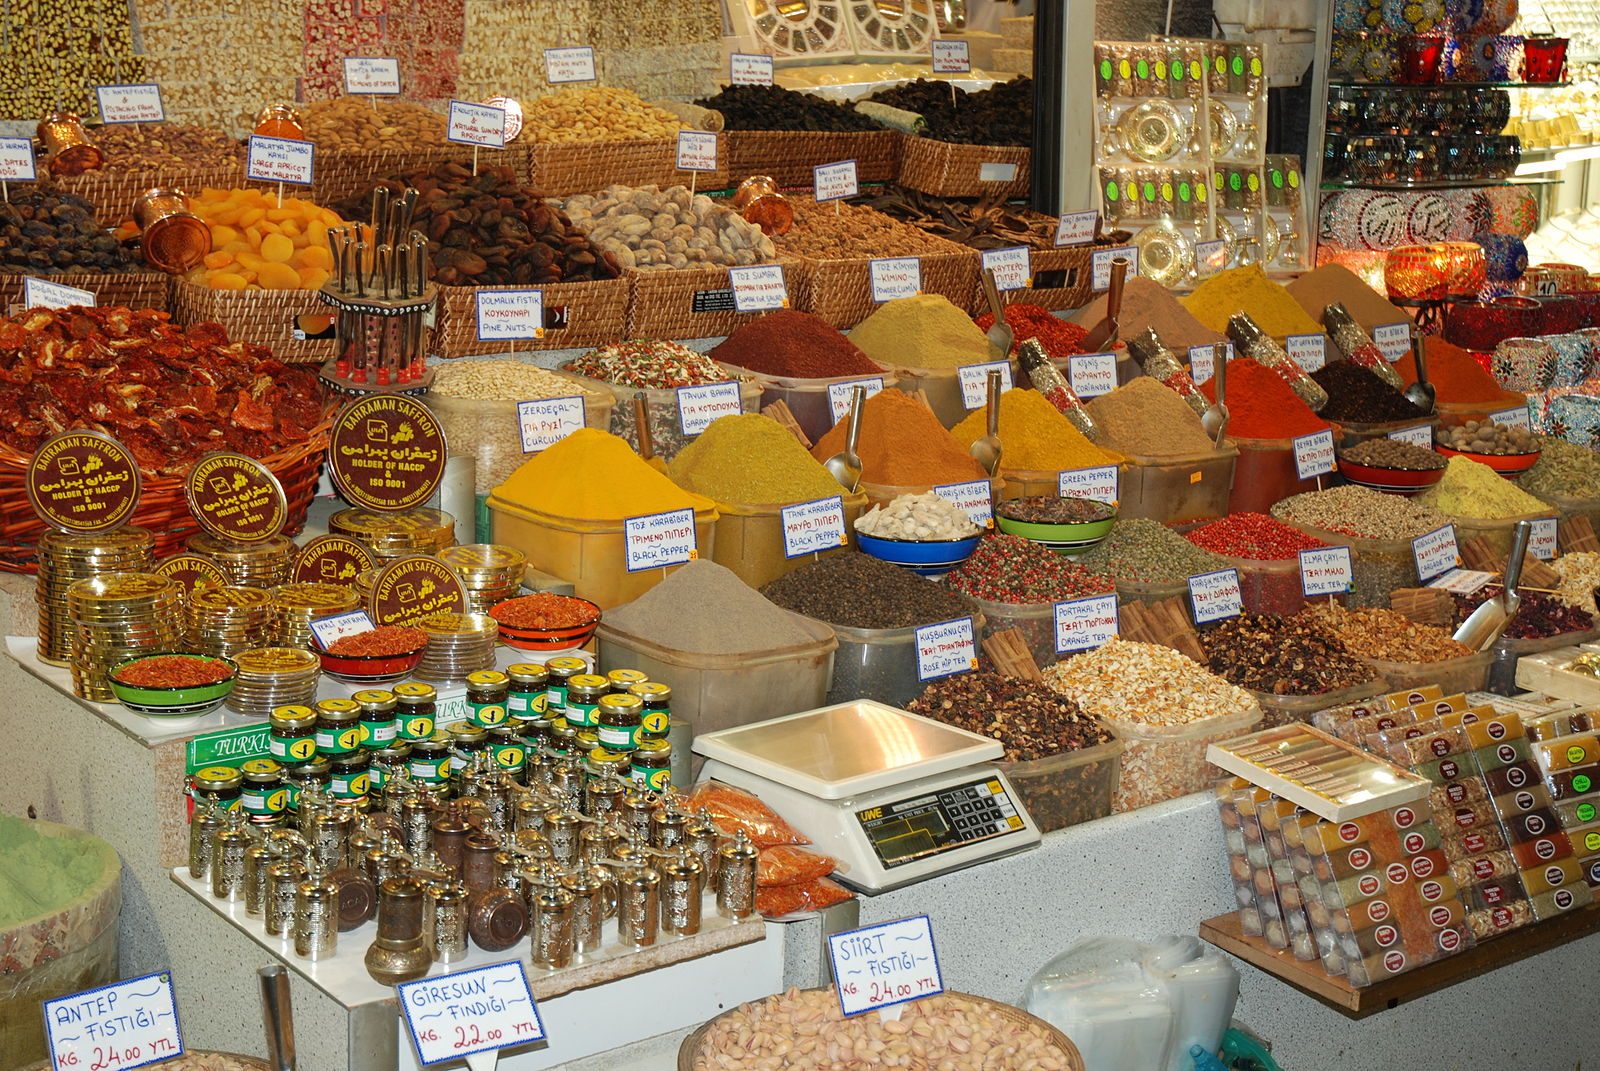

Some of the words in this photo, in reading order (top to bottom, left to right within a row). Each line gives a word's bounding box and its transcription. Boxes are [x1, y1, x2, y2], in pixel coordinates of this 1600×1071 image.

[454, 122, 478, 132] NATURAL
[462, 132, 488, 142] APRICOT
[252, 142, 284, 150] MALATYA
[286, 144, 309, 154] JUMBO
[268, 152, 288, 160] KAYISI
[252, 159, 273, 168] LARGE
[277, 162, 306, 173] APRICOT
[252, 168, 270, 176] FROM
[272, 171, 302, 180] MALATYA
[736, 272, 750, 281] TOZ
[481, 296, 515, 305] DOLMALIK
[483, 323, 502, 332] PINE
[505, 323, 527, 332] NUTS
[683, 391, 707, 400] TAVUK
[710, 388, 736, 398] BAHARI
[344, 400, 396, 430] BAHRAMAN
[397, 401, 436, 438] SAFFRON
[522, 404, 570, 417] ZERDEÇAL
[36, 437, 80, 471] BAHRAMAN
[81, 437, 122, 462] SAFFRON
[352, 458, 383, 469] HOLDER
[398, 462, 426, 472] HACCP
[195, 459, 224, 492] BAHRAMAN
[224, 458, 260, 477] SAFFRON
[385, 470, 392, 478] &
[1062, 474, 1086, 485] GREEN
[1089, 470, 1114, 480] PEPPER
[370, 478, 384, 487] ISO
[386, 479, 406, 488] 9001
[52, 490, 82, 500] HOLDER
[96, 485, 120, 494] HACCP
[87, 502, 107, 511] 9001
[216, 506, 240, 518] HOLDER
[249, 497, 270, 508] HACCP
[787, 508, 805, 519] TANE
[808, 501, 843, 516] KARABİBER
[629, 521, 645, 531] TOZ
[649, 514, 689, 527] KARABİBER
[790, 536, 812, 548] BLACK
[815, 530, 840, 542] PEPPER
[304, 543, 343, 568] BAHRAMAN
[632, 550, 657, 561] BLACK
[661, 544, 688, 556] PEPPER
[1304, 554, 1322, 564] ELMA
[1324, 553, 1339, 565] ÇAYI
[191, 560, 225, 587] SAFFRON
[379, 562, 414, 601] BAHRAMAN
[415, 561, 451, 583] SAFFRON
[1307, 582, 1325, 590] APPLE
[1059, 604, 1094, 617] PORTAKAL
[1096, 601, 1112, 614] ÇAYI
[316, 620, 335, 632] YERLİ
[338, 615, 366, 627] SAFRAN
[920, 626, 957, 643] KUŞBURNU
[957, 624, 971, 638] ÇAYI
[1062, 636, 1089, 647] ORANGE
[923, 662, 940, 673] ROSE
[954, 656, 966, 665] TEA
[860, 807, 883, 822] UWE
[840, 933, 886, 961] SİİRT
[867, 952, 917, 976] FISTIĞI
[412, 976, 486, 1007] GİRESUN
[869, 980, 911, 1002] 24.00
[916, 977, 936, 991] YTL
[55, 991, 118, 1026] ANTEP
[446, 996, 506, 1020] FINDIĞI
[84, 1007, 156, 1042] FISTIĞI
[418, 1029, 442, 1043] KG.
[453, 1024, 503, 1048] 22.00
[512, 1022, 537, 1035] YTL
[57, 1052, 82, 1068] KG.
[90, 1046, 141, 1071] 24.00
[149, 1038, 176, 1055] YTL
